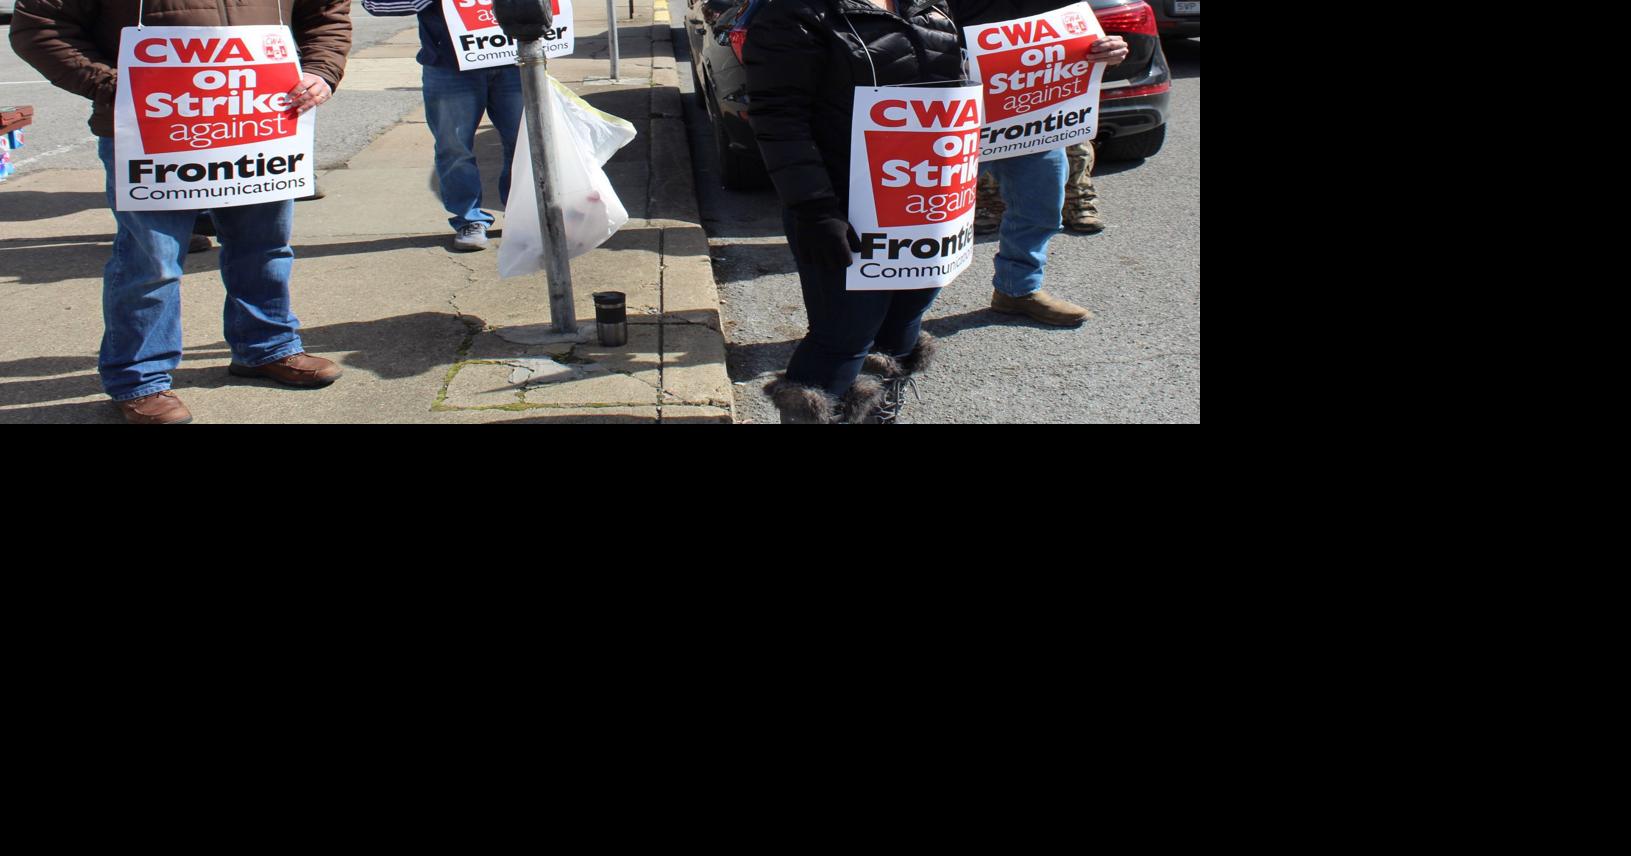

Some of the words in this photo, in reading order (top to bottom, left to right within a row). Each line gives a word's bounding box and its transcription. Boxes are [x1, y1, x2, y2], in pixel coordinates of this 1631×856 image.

[459, 25, 567, 51] Froer
[977, 18, 1061, 51] CWA
[133, 37, 255, 64] CWA
[465, 42, 569, 62] Commuions
[1020, 44, 1065, 67] on
[192, 68, 257, 91] on
[989, 60, 1088, 95] Strike
[145, 90, 292, 118] Strike
[1003, 77, 1082, 113] against
[870, 98, 979, 128] CWA
[980, 106, 1092, 144] Frontier
[169, 113, 287, 148] against
[933, 132, 978, 157] on
[979, 125, 1091, 156] ommunications
[128, 152, 305, 184] Frontier
[881, 156, 978, 188] Strik
[129, 176, 306, 201] Communications
[905, 183, 976, 222] agains
[861, 223, 973, 260] Frontie
